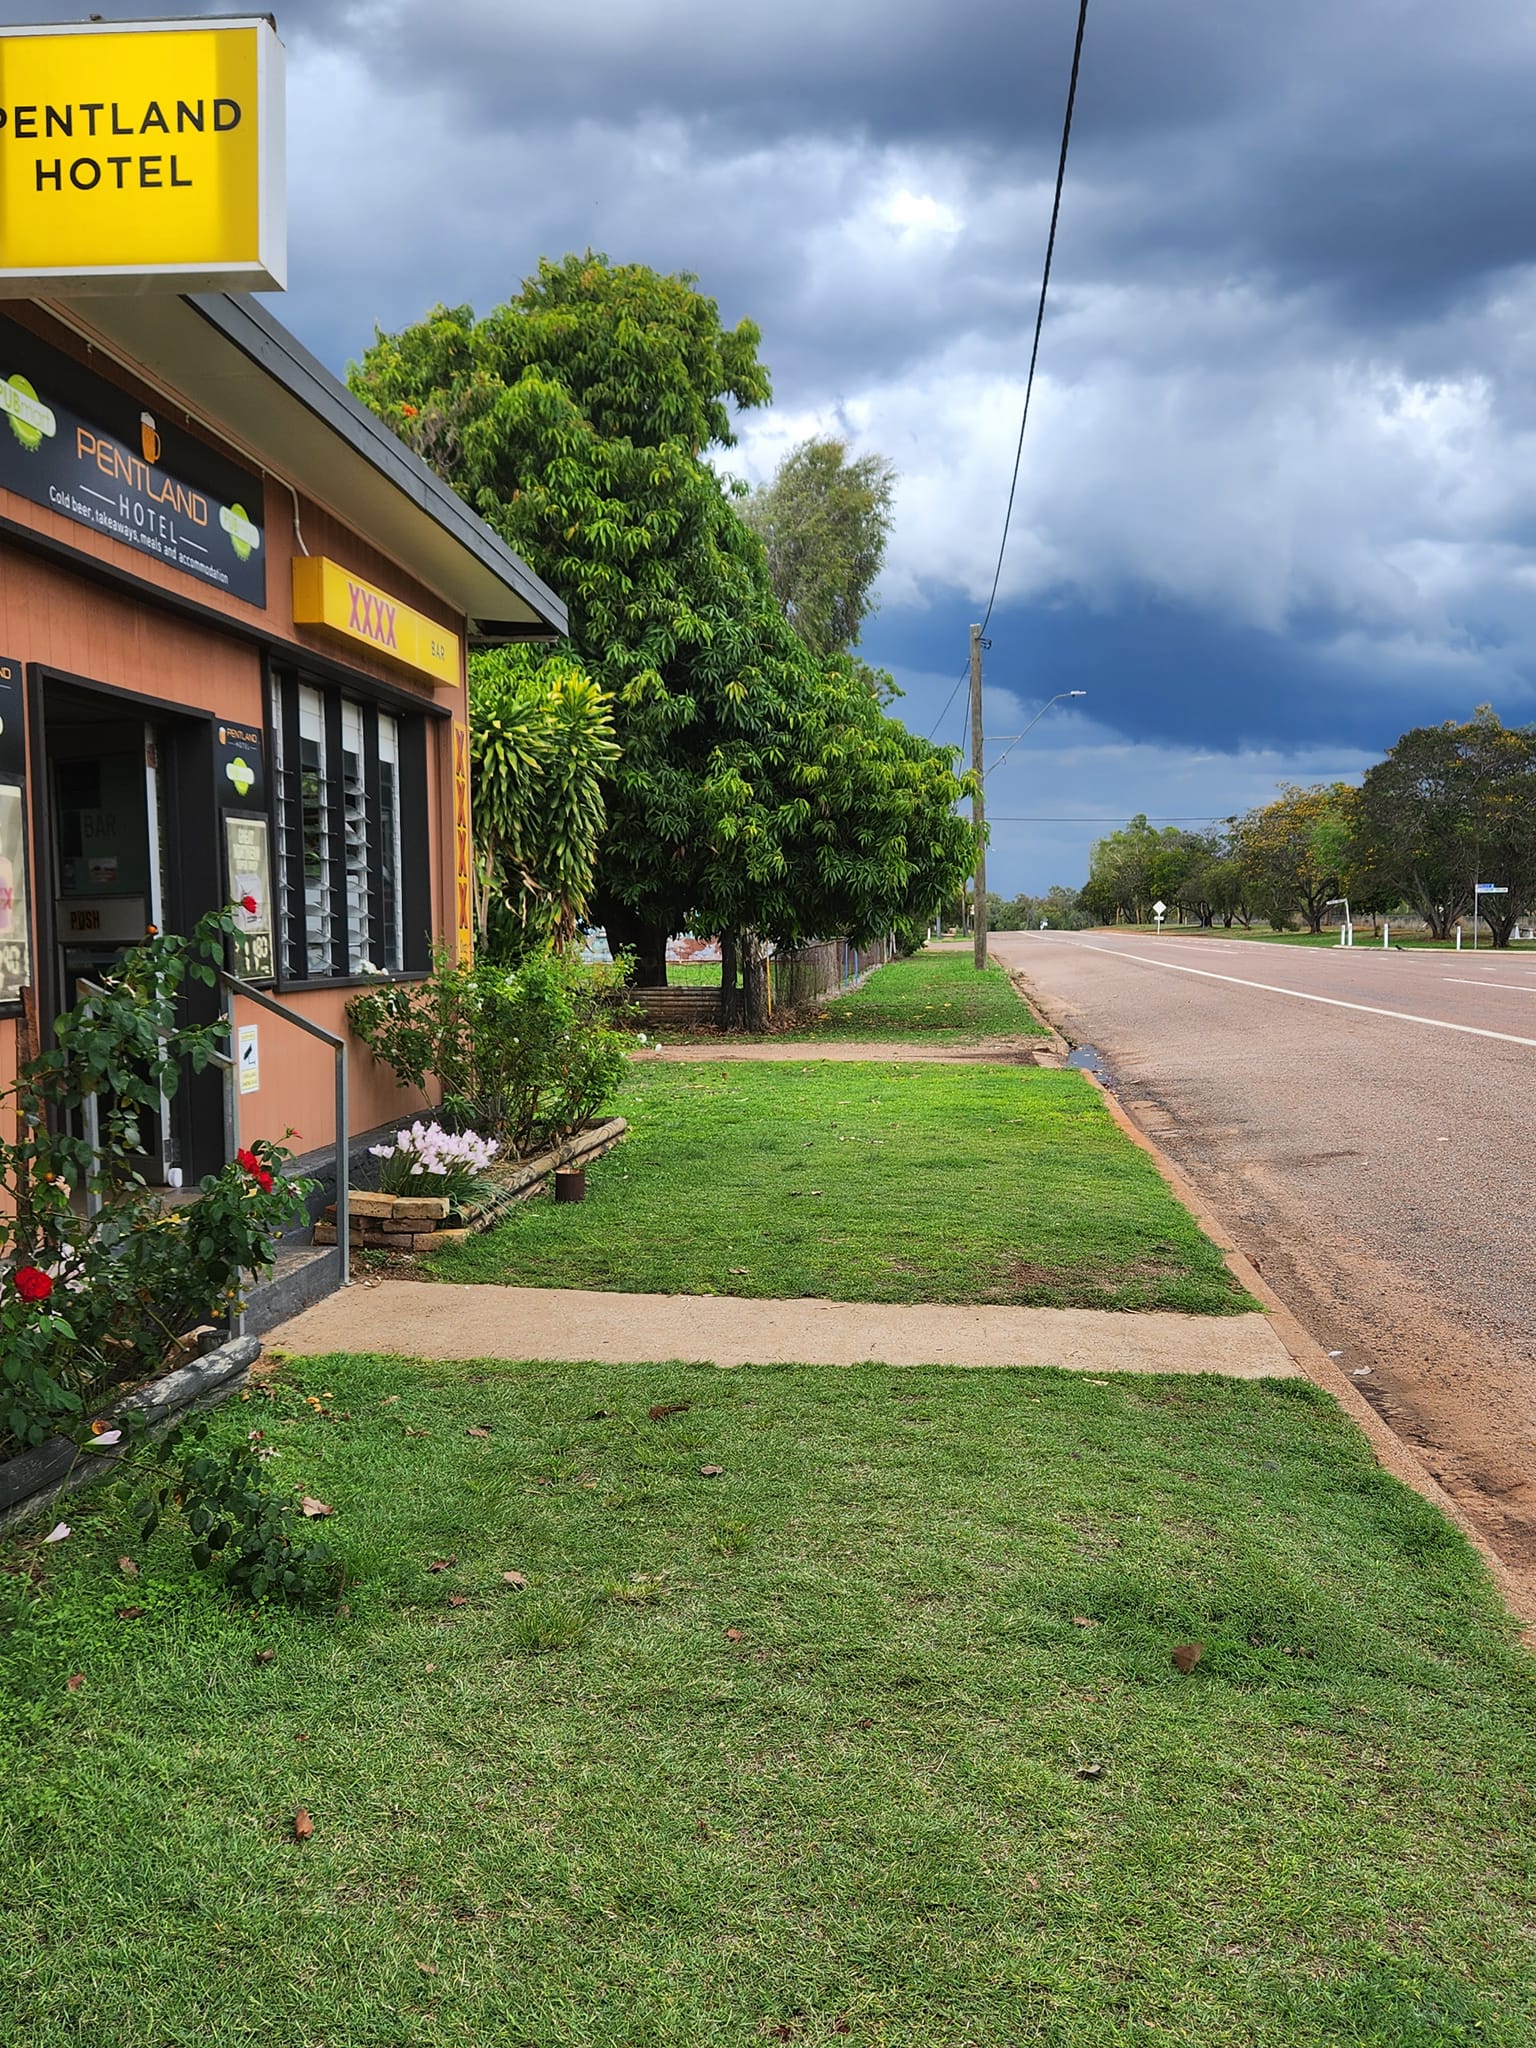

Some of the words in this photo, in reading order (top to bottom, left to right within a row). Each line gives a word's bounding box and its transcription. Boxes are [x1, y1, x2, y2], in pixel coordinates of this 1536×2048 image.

[35, 155, 193, 191] HOTEL
[76, 427, 208, 527] PENTLAND
[49, 485, 71, 509] Cold
[71, 495, 94, 521] beer,
[95, 509, 140, 543] takeaways,
[140, 533, 162, 553] meals
[163, 545, 177, 560] and
[178, 552, 229, 585] accommodation
[119, 493, 178, 545] HOTEL
[348, 581, 397, 650] XXXX
[431, 640, 445, 661] BAR
[226, 727, 258, 744] PENTLAND
[69, 910, 101, 930] PUSH
